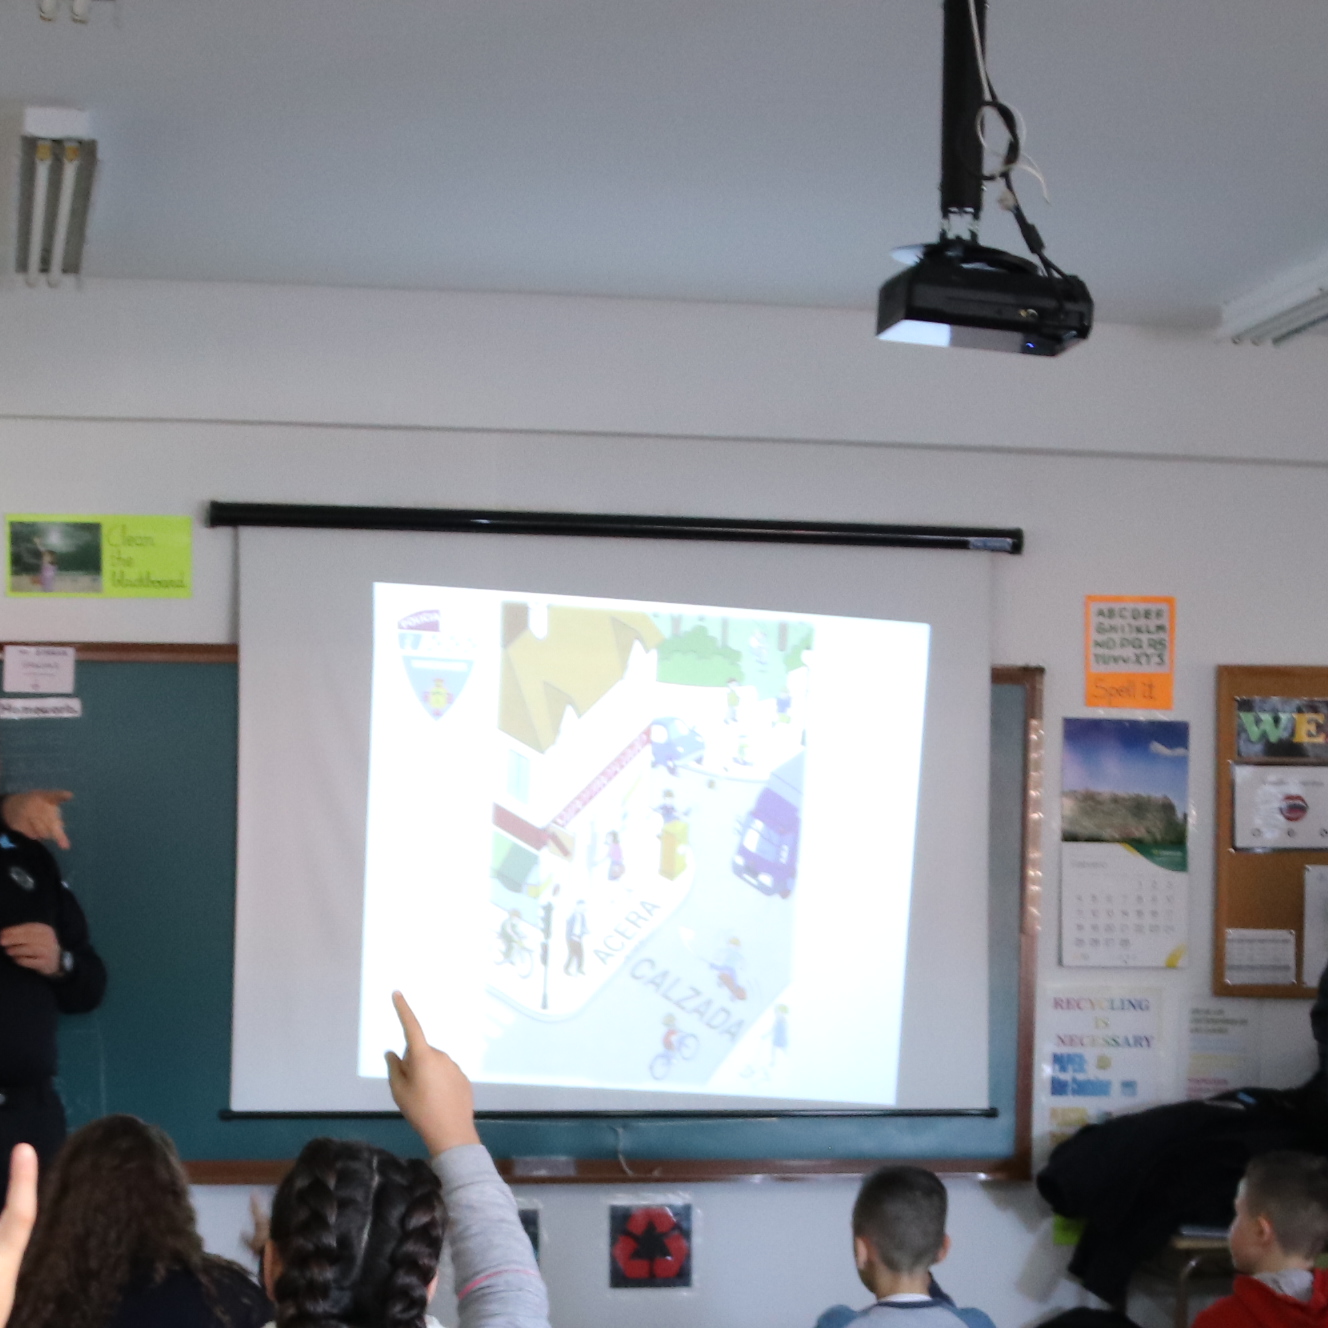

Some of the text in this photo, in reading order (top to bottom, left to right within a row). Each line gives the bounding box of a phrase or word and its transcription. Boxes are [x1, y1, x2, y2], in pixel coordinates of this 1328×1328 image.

[107, 524, 155, 547] Clean
[593, 900, 661, 965] ACERA
[629, 958, 745, 1043] CALZADA
[1053, 997, 1150, 1012] RECYCLING
[1094, 1016, 1110, 1029] IS
[1056, 1034, 1154, 1048] NECESSARY
